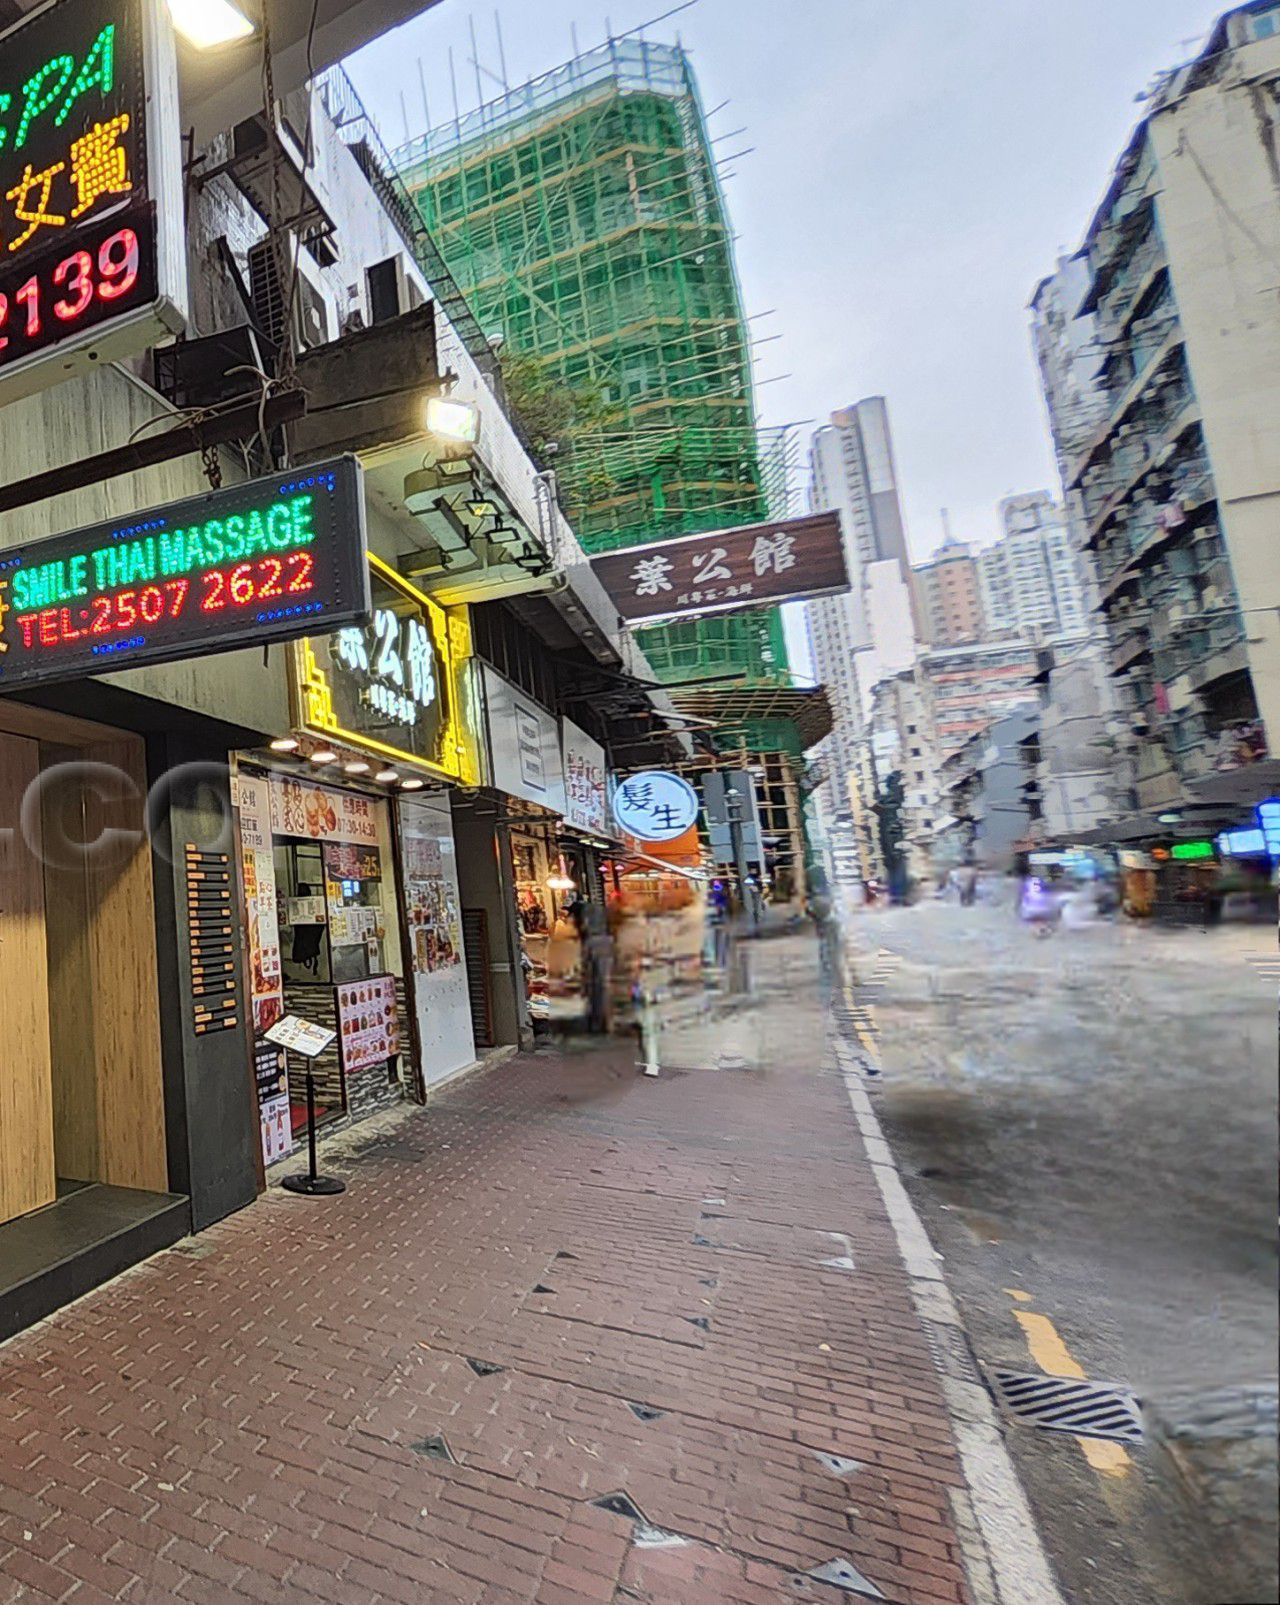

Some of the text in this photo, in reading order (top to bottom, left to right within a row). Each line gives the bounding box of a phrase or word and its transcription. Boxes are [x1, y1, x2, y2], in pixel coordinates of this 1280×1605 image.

[12, 495, 317, 611] SMILE THAI MASSAGE
[16, 552, 315, 648] TEL:2507 2622
[629, 532, 798, 596] 葉公館
